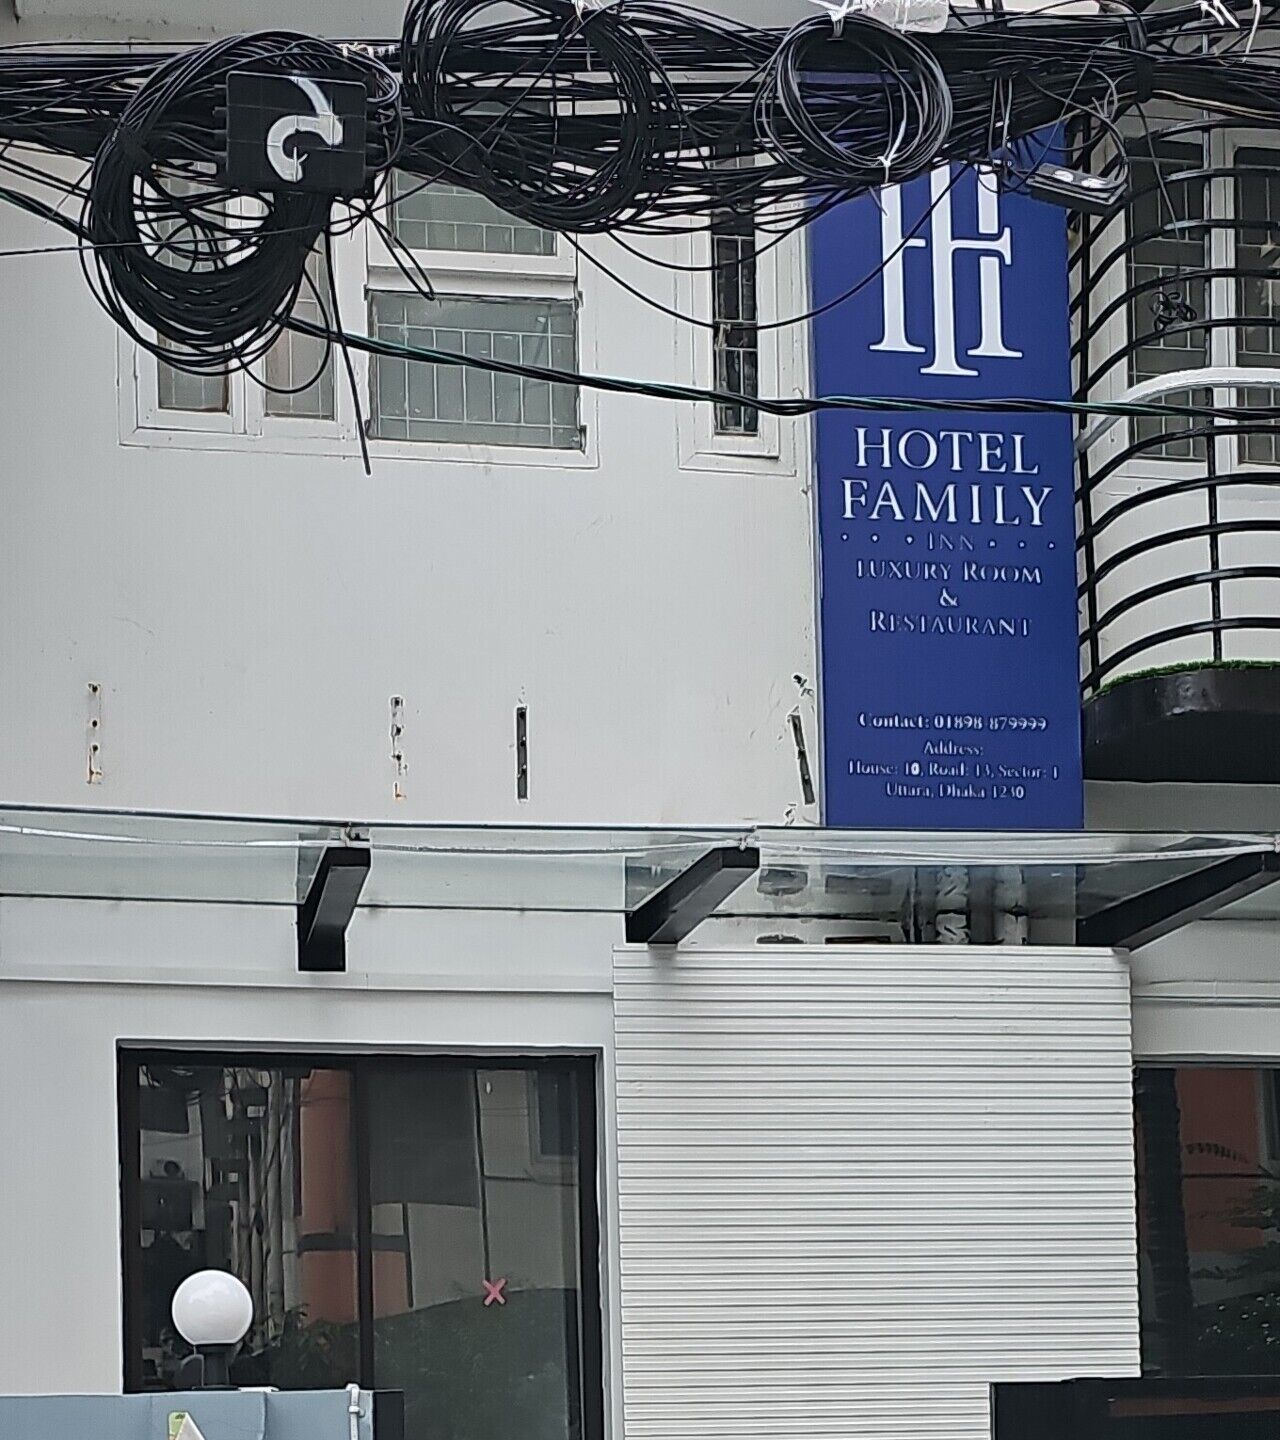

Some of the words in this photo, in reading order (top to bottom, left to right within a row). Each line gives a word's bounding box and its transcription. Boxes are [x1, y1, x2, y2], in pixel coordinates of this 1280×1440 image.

[854, 427, 1039, 474] HOTEL
[841, 479, 1053, 526] FAMILY
[928, 532, 974, 550] INN
[857, 560, 951, 580] LUXURY
[963, 561, 1042, 584] ROOM
[939, 588, 959, 607] &
[870, 611, 1030, 637] RESTAURANT
[859, 713, 930, 728] Contact:
[923, 740, 984, 756] Address:
[848, 760, 898, 775] House:
[929, 762, 969, 777] Road:
